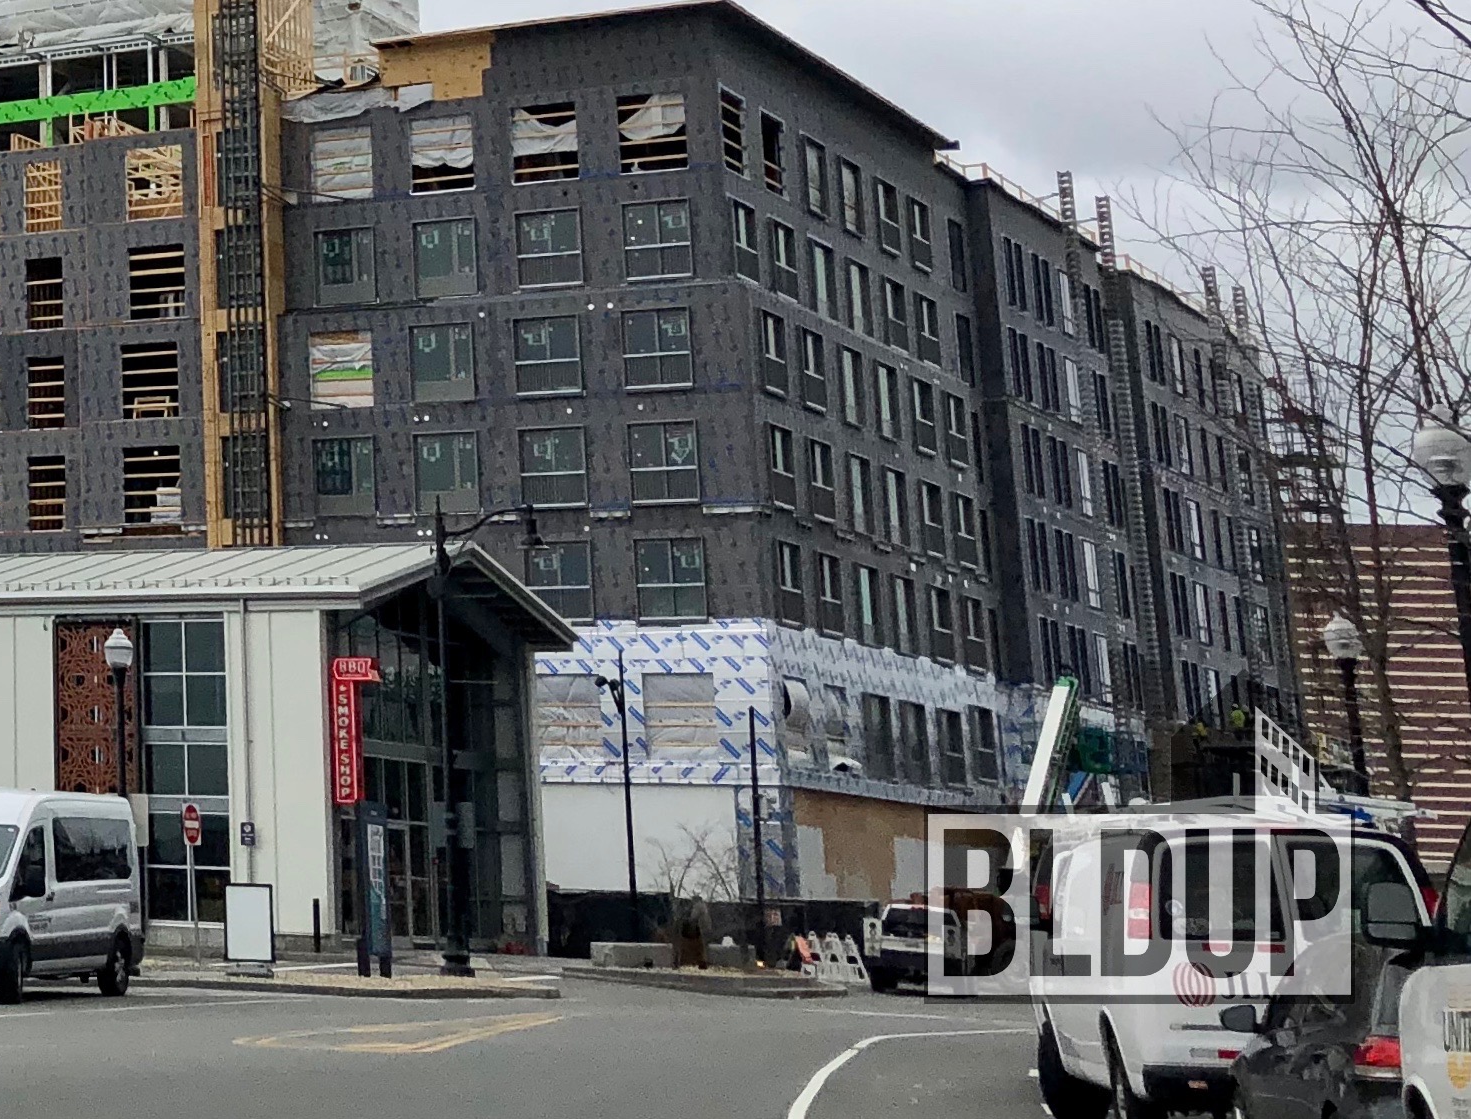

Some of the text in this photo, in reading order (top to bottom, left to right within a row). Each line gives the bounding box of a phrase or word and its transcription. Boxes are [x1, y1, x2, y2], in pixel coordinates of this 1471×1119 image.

[339, 661, 366, 673] BBQ
[338, 695, 351, 797] SMOKE SHOP
